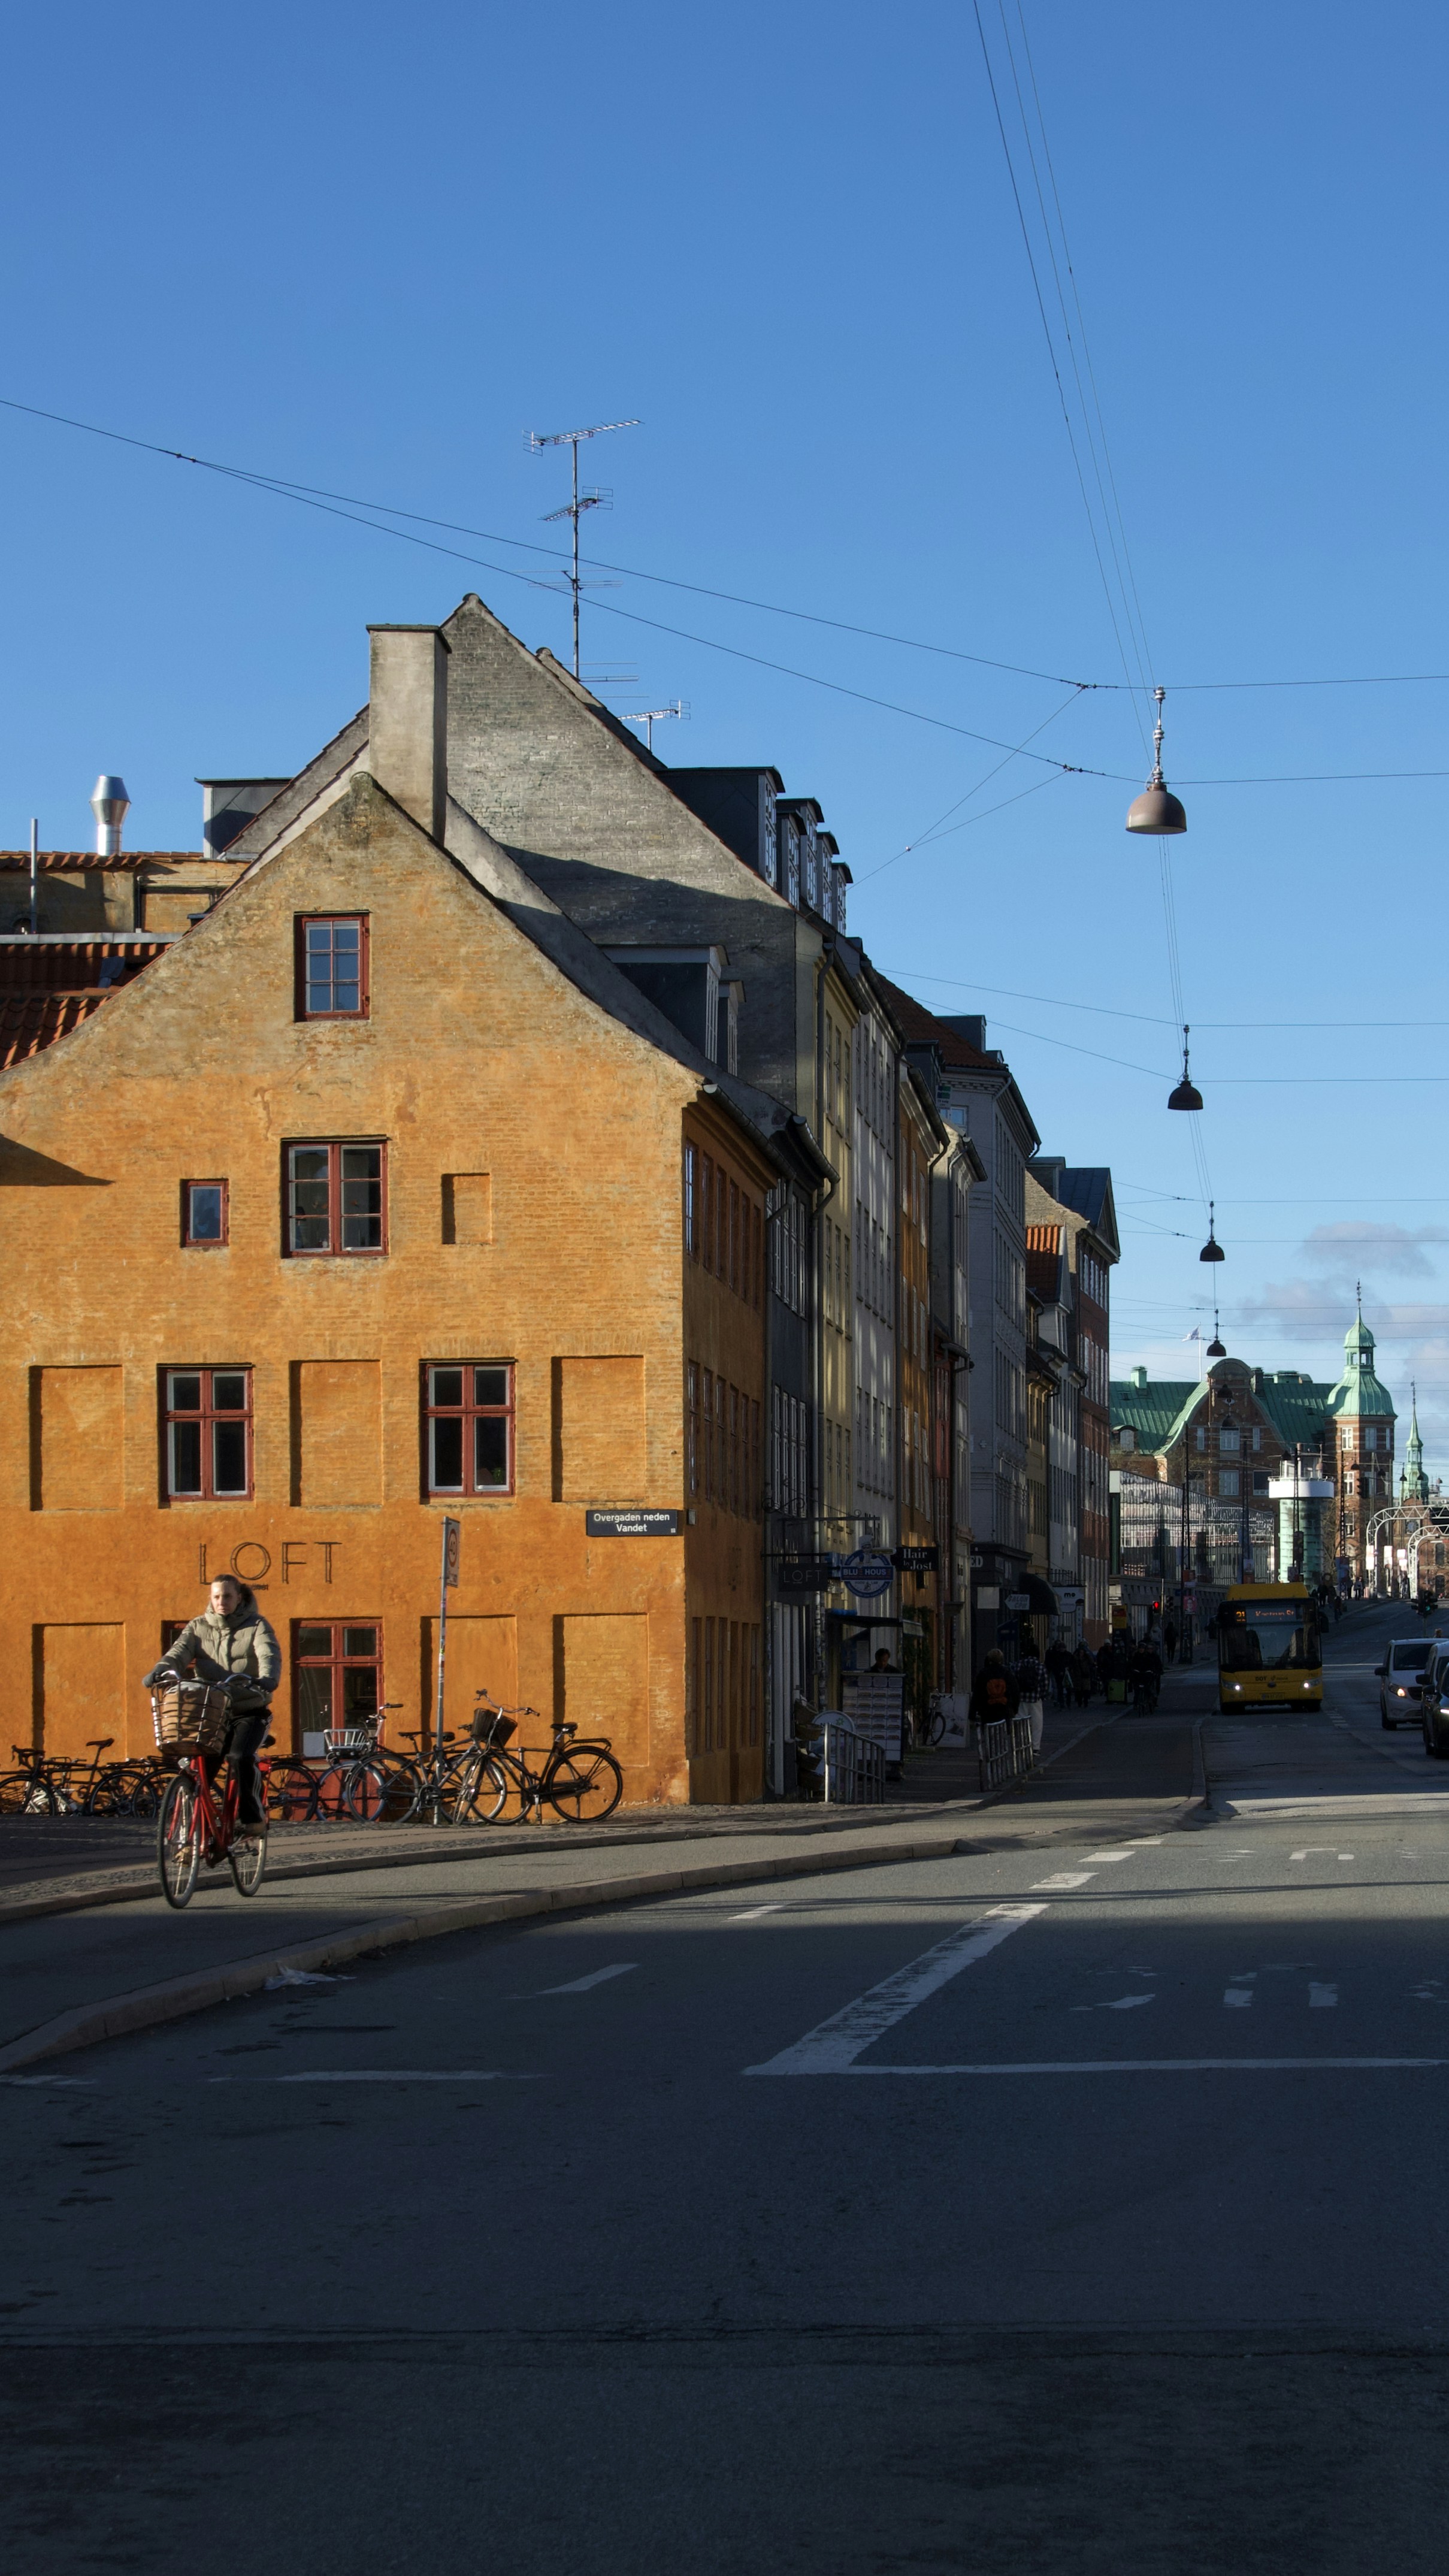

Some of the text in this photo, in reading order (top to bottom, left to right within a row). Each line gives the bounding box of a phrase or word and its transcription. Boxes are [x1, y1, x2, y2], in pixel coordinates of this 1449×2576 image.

[594, 1513, 670, 1523] Overgaden neden
[903, 1548, 927, 1559] Hair
[199, 1541, 343, 1585] LOFT
[910, 1559, 933, 1570] Jost
[784, 1570, 821, 1583] LOFT
